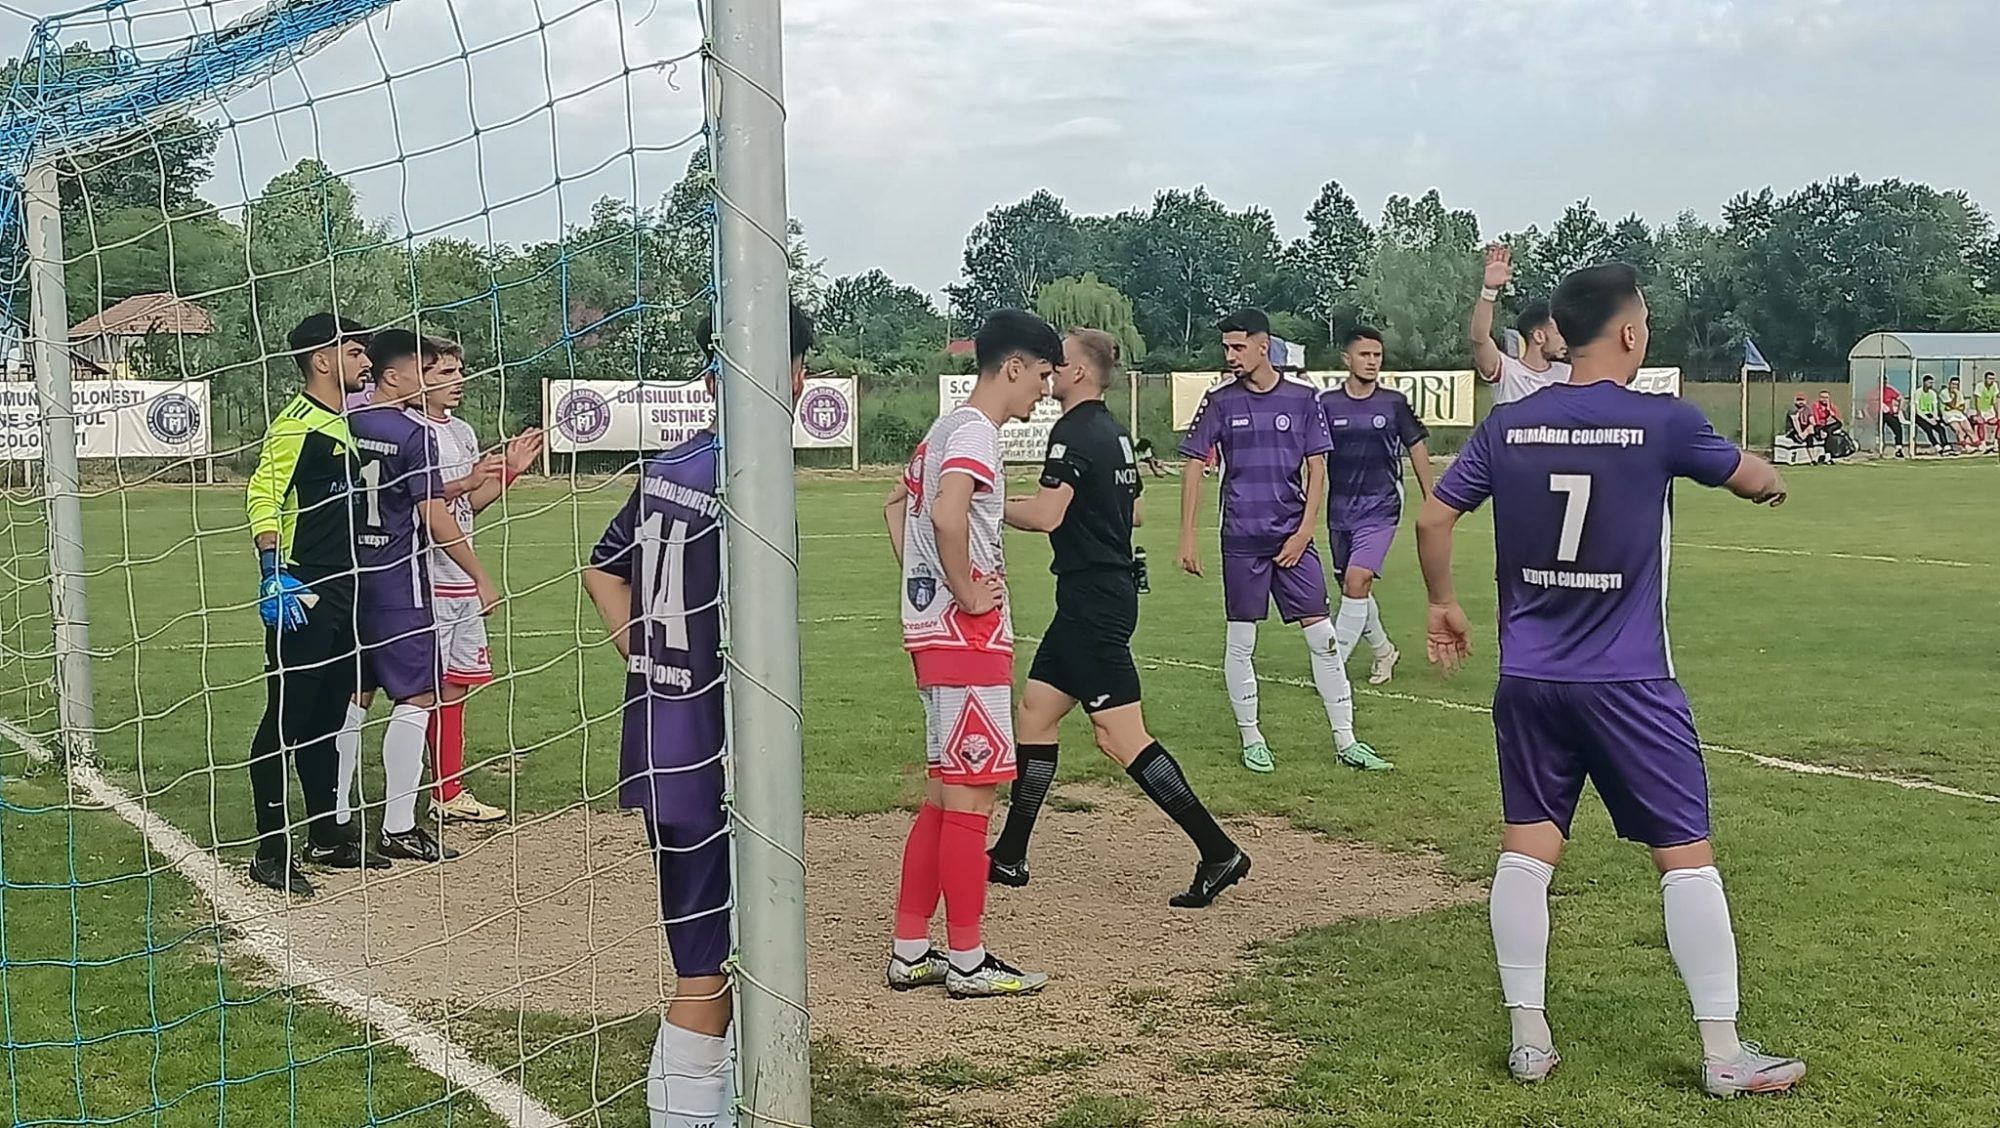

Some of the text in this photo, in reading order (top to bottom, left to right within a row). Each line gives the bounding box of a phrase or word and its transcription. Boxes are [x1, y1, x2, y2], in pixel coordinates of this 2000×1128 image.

[70, 389, 145, 405] OLONESTI
[617, 389, 684, 404] CONSILIUL
[660, 428, 683, 442] DIN
[1506, 425, 1570, 444] PRIMĂRIA
[1549, 473, 1592, 562] 7
[635, 512, 690, 651] 14
